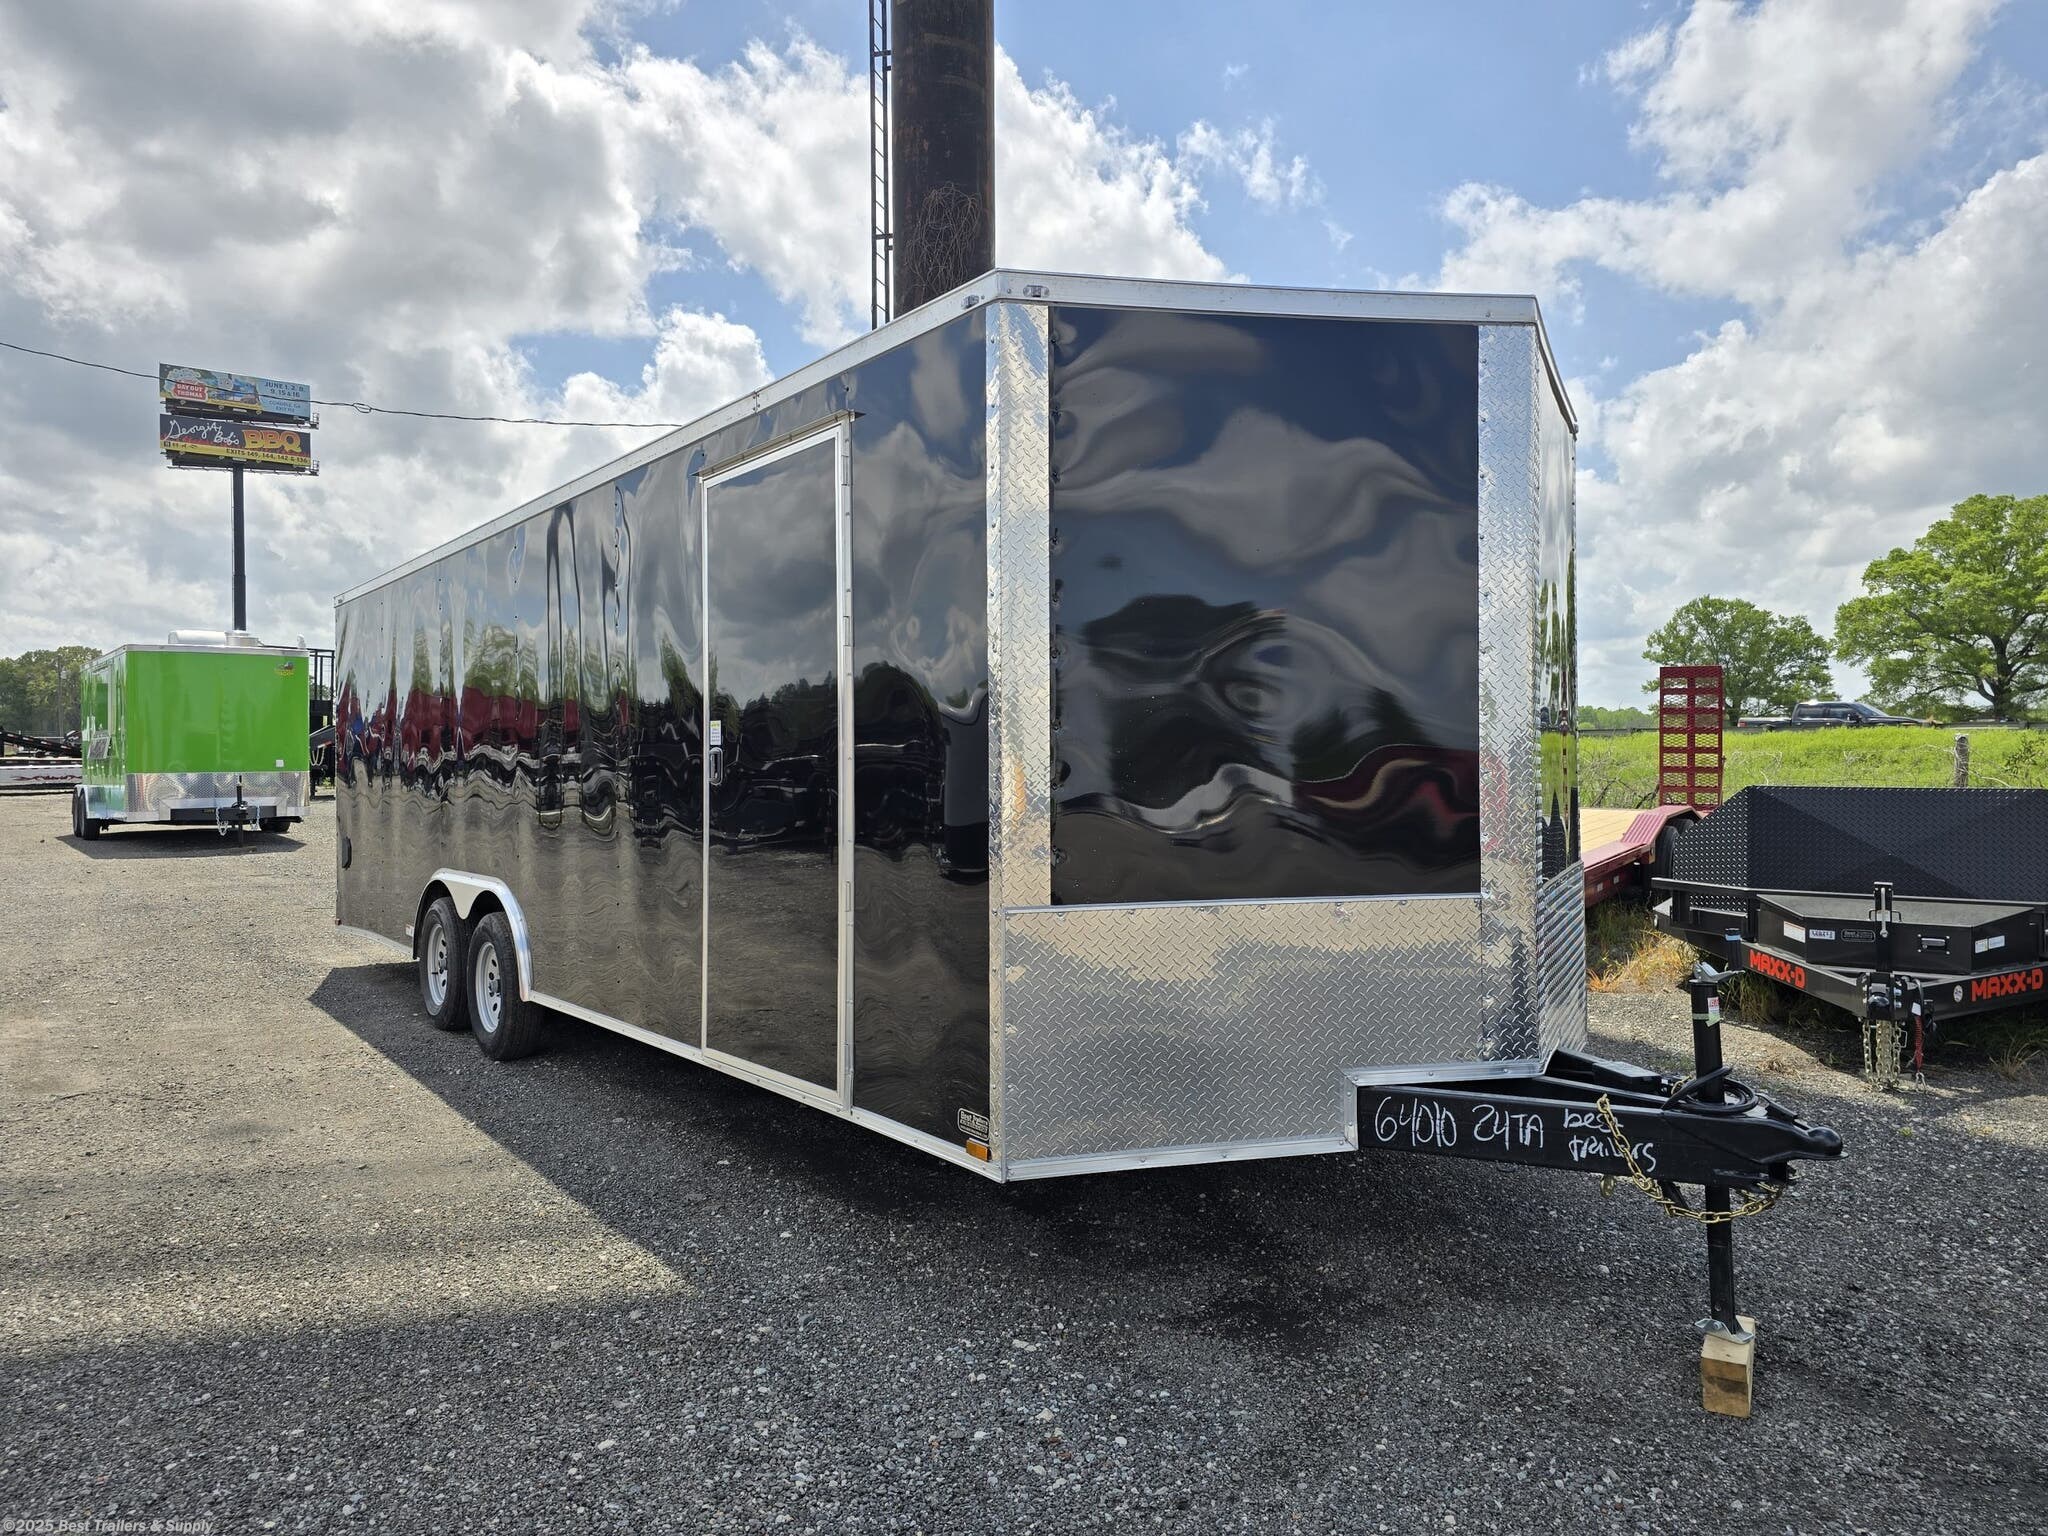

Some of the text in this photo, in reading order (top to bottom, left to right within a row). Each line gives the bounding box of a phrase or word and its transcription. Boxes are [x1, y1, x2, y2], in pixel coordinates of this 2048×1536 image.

[176, 383, 204, 393] DAY OUT
[265, 381, 284, 390] JUNE
[176, 389, 204, 399] THOMAS
[242, 430, 303, 453] BBQ
[226, 448, 245, 456] EXITS
[1568, 1134, 1657, 1172] trailrs
